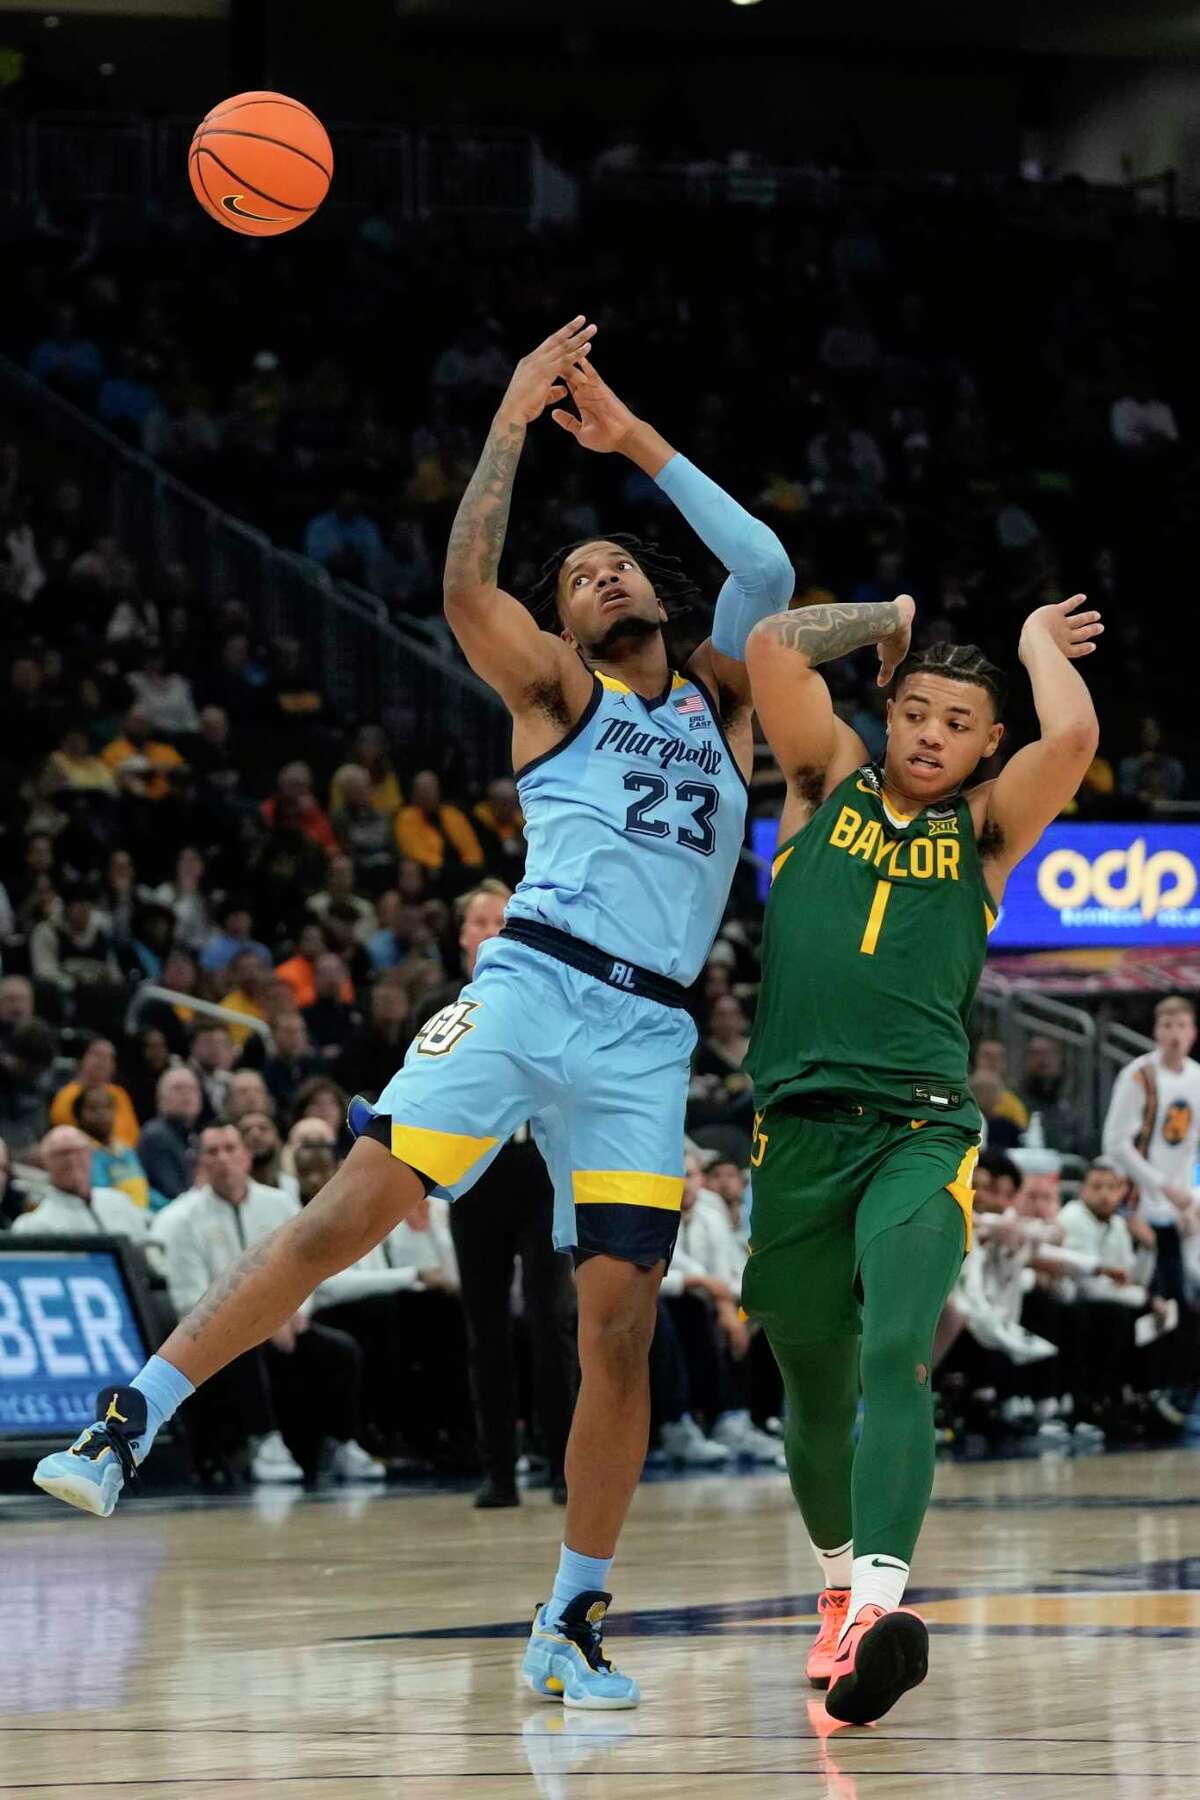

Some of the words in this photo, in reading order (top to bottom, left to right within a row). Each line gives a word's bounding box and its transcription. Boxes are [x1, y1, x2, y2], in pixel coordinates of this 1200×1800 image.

[595, 717, 722, 775] Marquette
[689, 720, 711, 729] EAST
[622, 771, 720, 857] 23
[829, 805, 960, 880] BAYLOR
[1037, 837, 1197, 920] odp
[860, 880, 892, 955] 1
